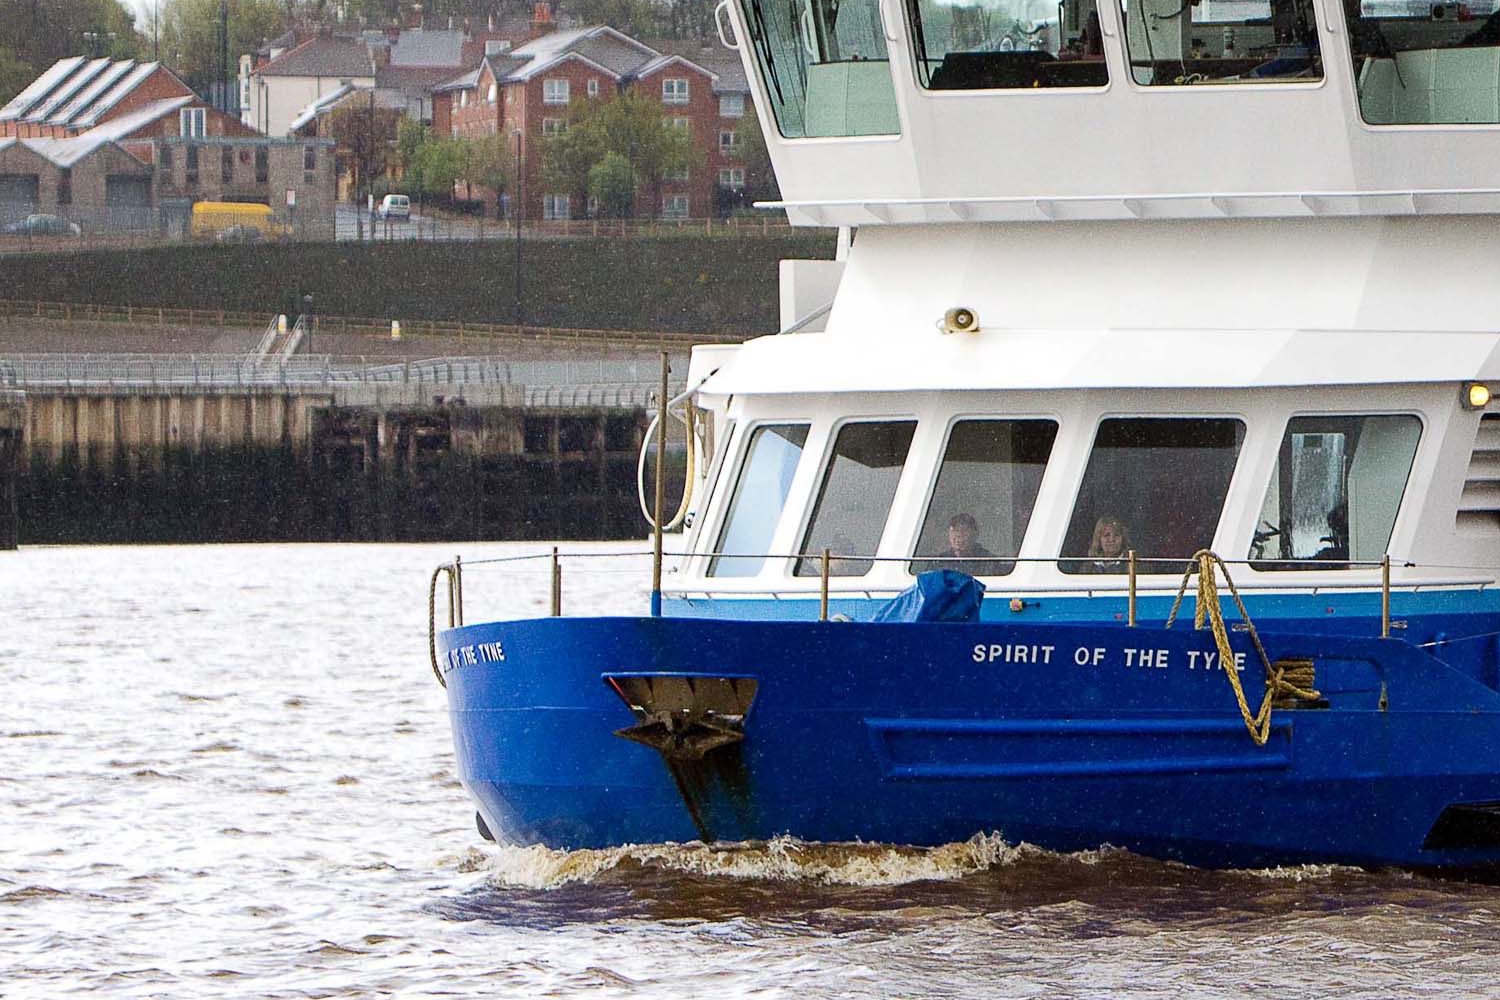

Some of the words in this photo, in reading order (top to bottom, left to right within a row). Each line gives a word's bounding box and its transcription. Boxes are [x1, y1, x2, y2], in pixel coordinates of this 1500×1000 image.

[461, 644, 477, 665] THE
[478, 641, 505, 663] TYNE
[972, 644, 1055, 664] SPIRIT
[1074, 646, 1106, 666] OF
[1123, 648, 1169, 667] THE
